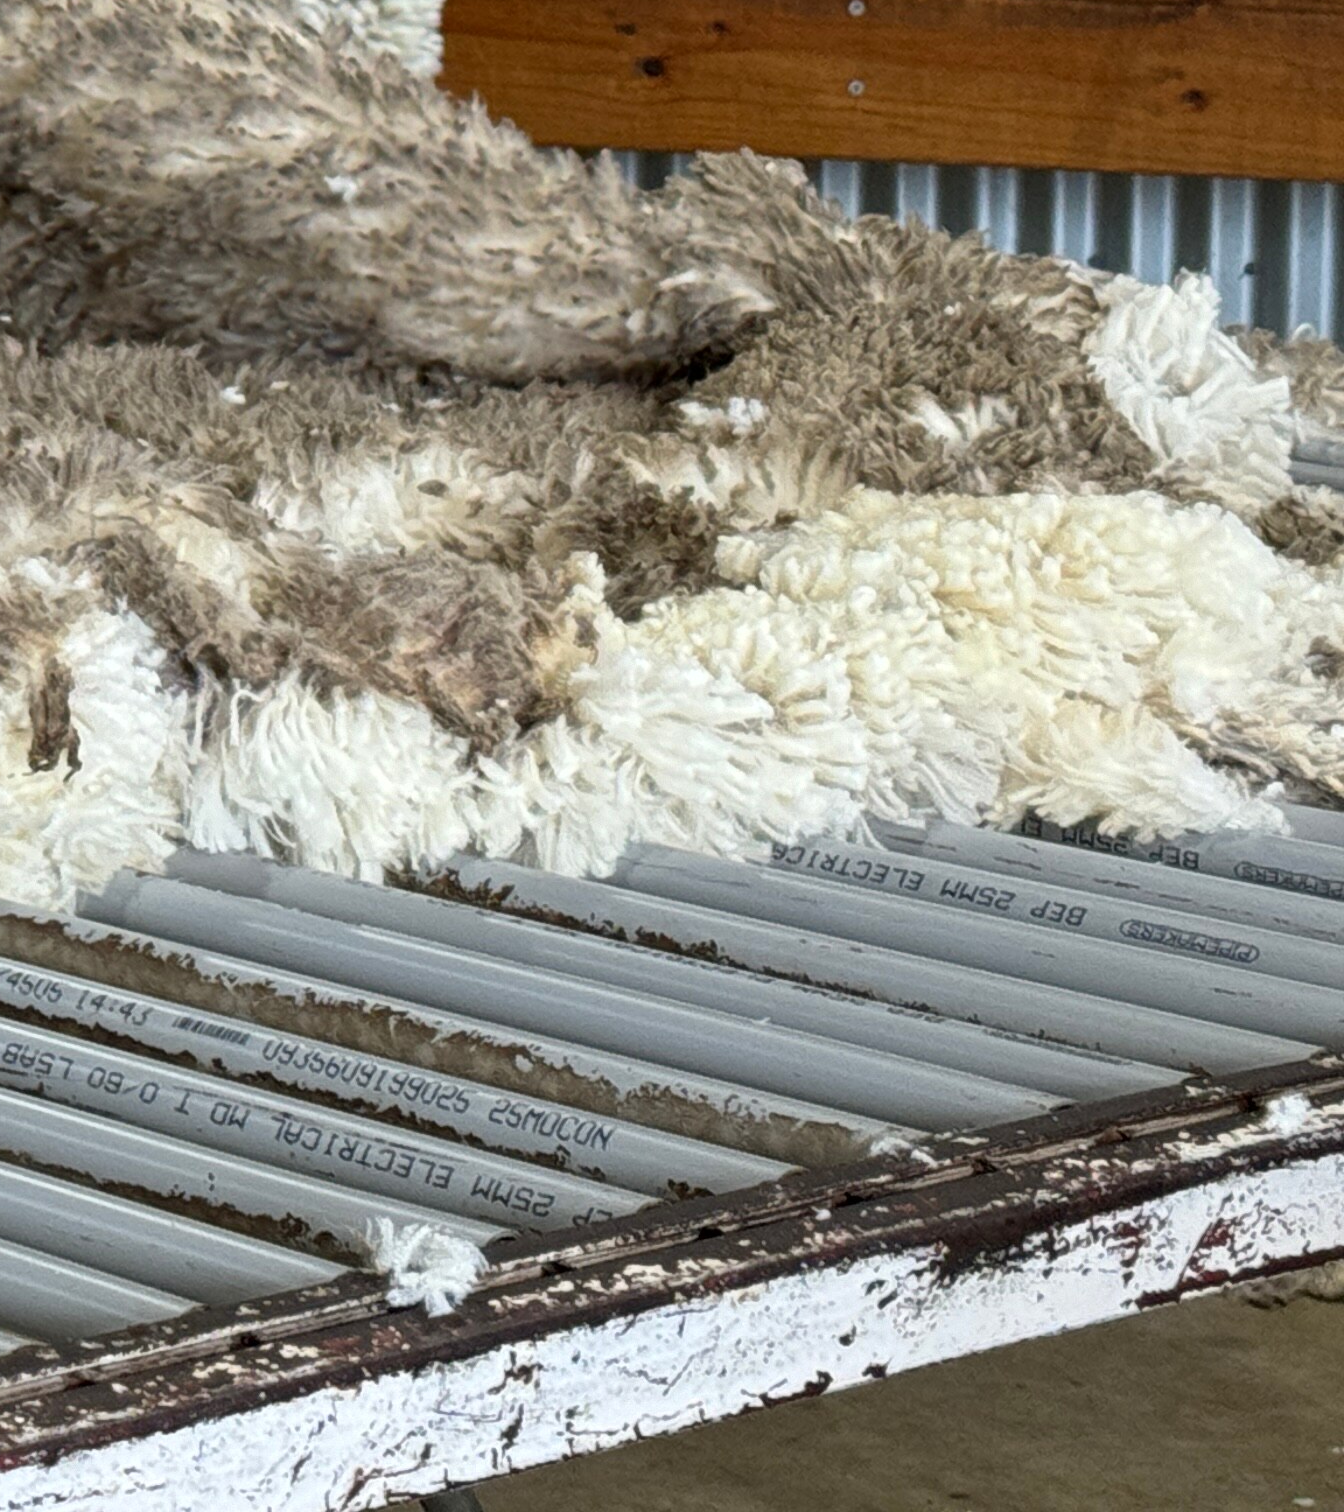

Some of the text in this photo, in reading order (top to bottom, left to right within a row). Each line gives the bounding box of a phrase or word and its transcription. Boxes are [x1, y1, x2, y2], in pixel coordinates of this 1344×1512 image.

[768, 842, 924, 891] ELECTRICA
[938, 878, 1015, 911] 25MM
[1029, 897, 1087, 926] BEP
[84, 1065, 160, 1105] 0/60
[173, 1090, 194, 1115] T
[208, 1100, 250, 1130] MD
[264, 1115, 454, 1189] ELECTRICAL
[469, 1173, 555, 1217] 25MM
